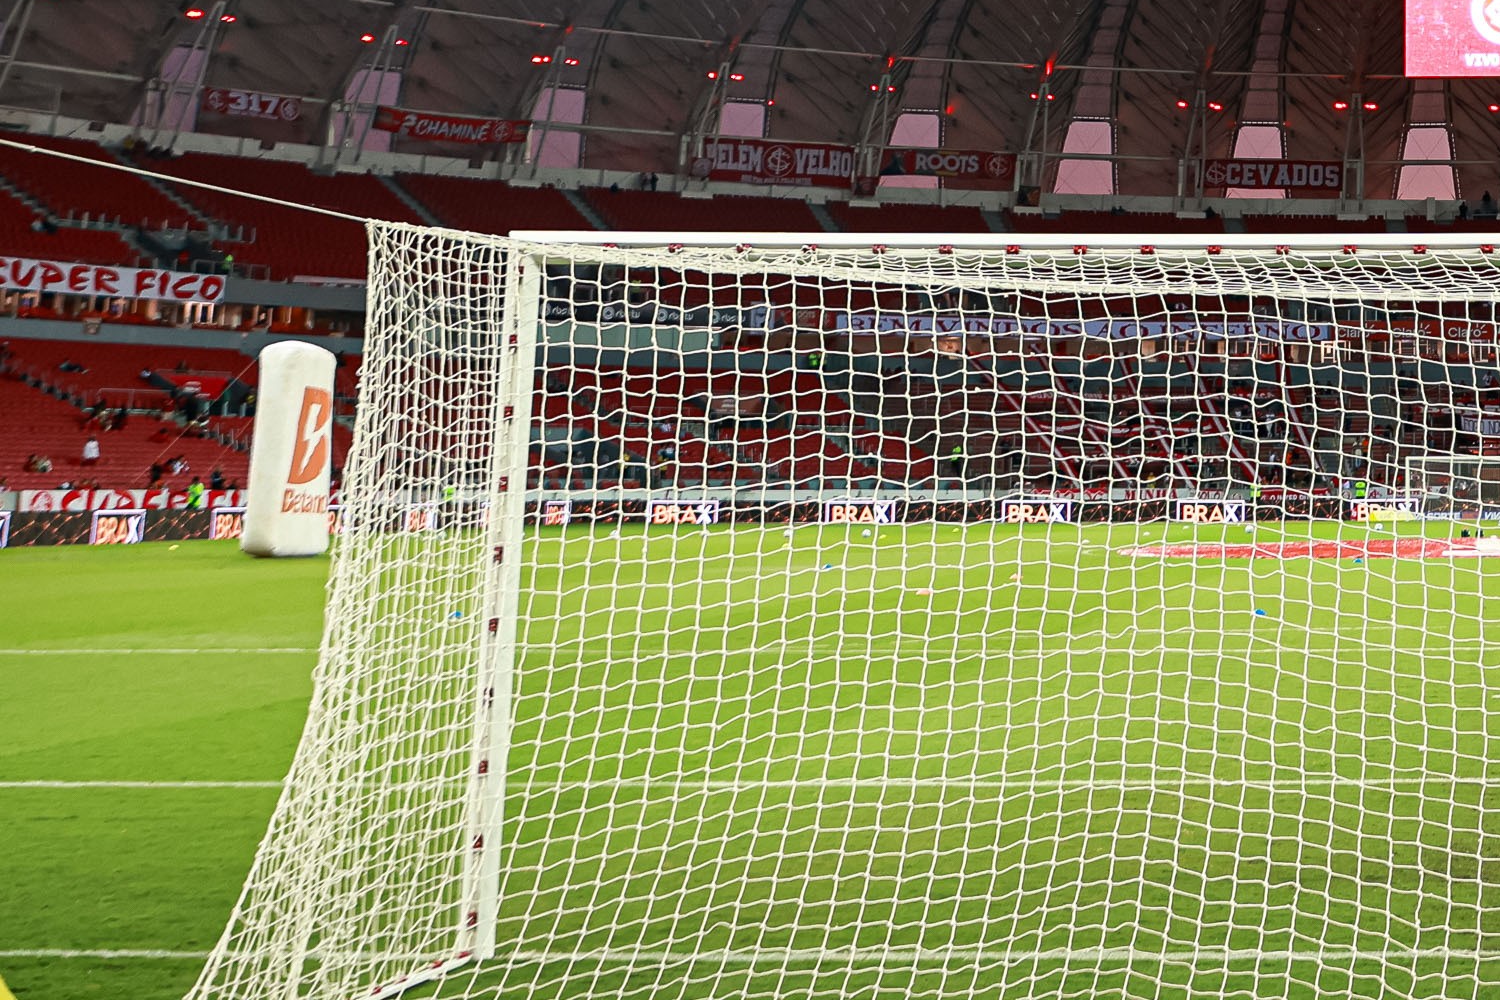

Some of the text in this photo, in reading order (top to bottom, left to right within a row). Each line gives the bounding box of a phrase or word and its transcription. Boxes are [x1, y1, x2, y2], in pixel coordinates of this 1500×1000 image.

[1464, 53, 1500, 68] VIVO
[228, 91, 279, 115] 317
[795, 148, 852, 178] VELHO
[915, 153, 980, 173] ROOTS
[1225, 163, 1340, 187] CEVADOS
[135, 269, 224, 301] FICO
[844, 315, 1321, 340] BEM-VINDOS AO INFERNO
[281, 488, 327, 513] Betan
[653, 505, 712, 524] BRAX
[831, 504, 890, 523] BRAX
[1007, 503, 1067, 523] BRAX
[1182, 504, 1240, 523] BRAX
[96, 516, 143, 544] BRAX
[214, 514, 242, 540] BRA
